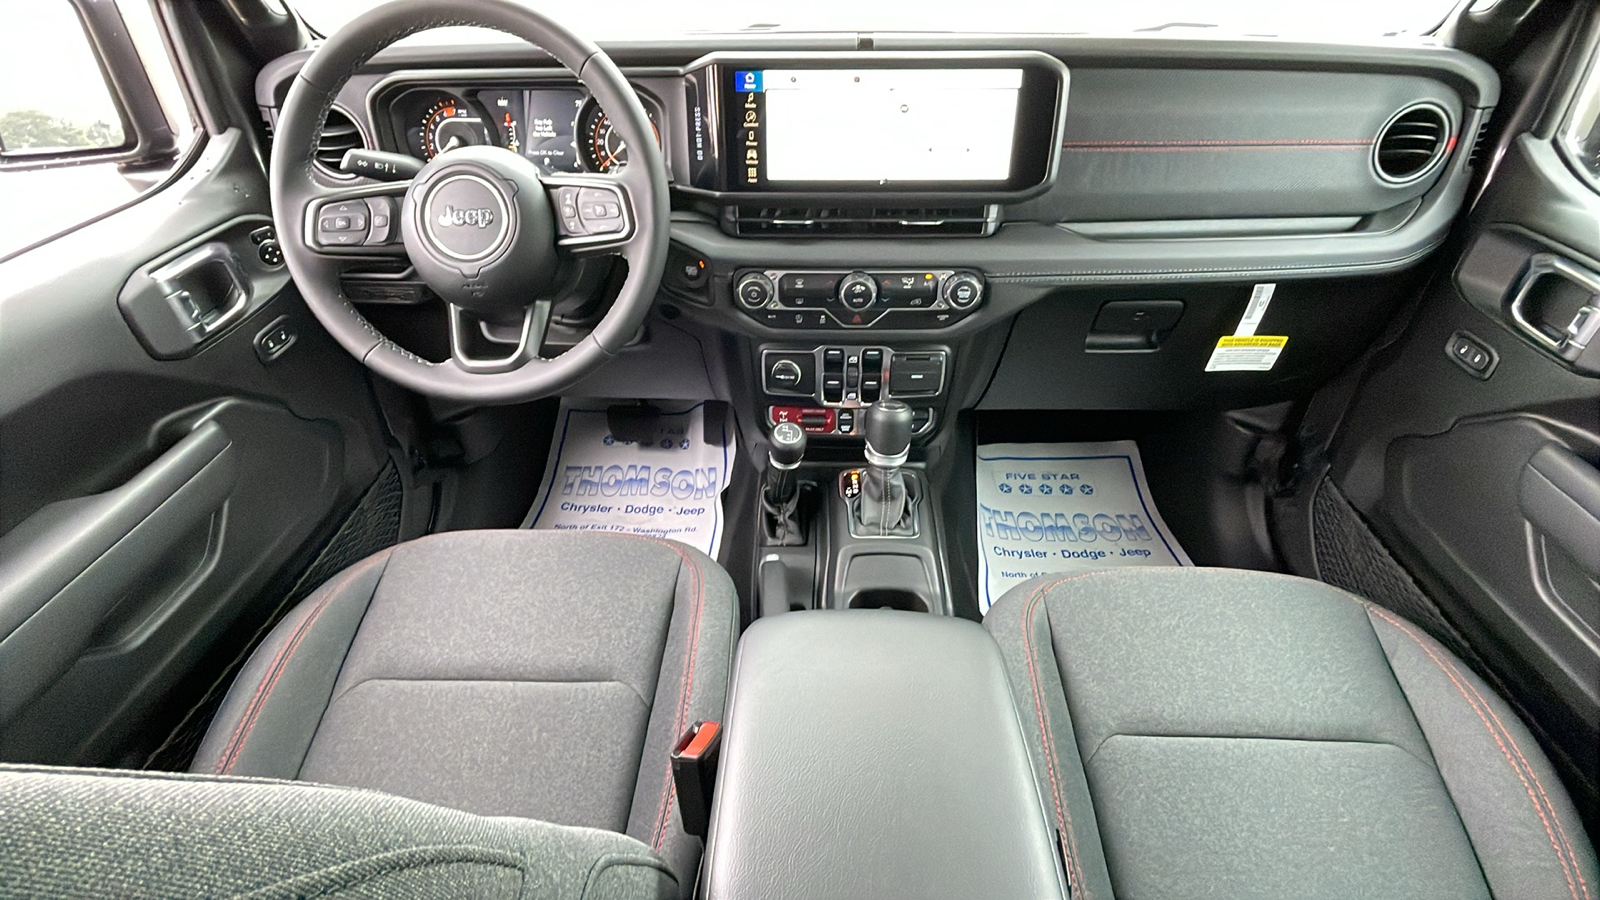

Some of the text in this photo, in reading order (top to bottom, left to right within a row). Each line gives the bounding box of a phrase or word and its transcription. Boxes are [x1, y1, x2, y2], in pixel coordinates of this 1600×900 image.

[695, 133, 703, 148] NOT
[437, 205, 493, 228] Jeep
[561, 464, 717, 500] THOMSON
[1042, 472, 1080, 480] STAR
[560, 501, 705, 516] Chrysler Dodge Jeep
[980, 503, 1152, 542] THOMSON
[633, 527, 682, 535] Washington
[993, 546, 1152, 560] Chrysler Dodge Jeep
